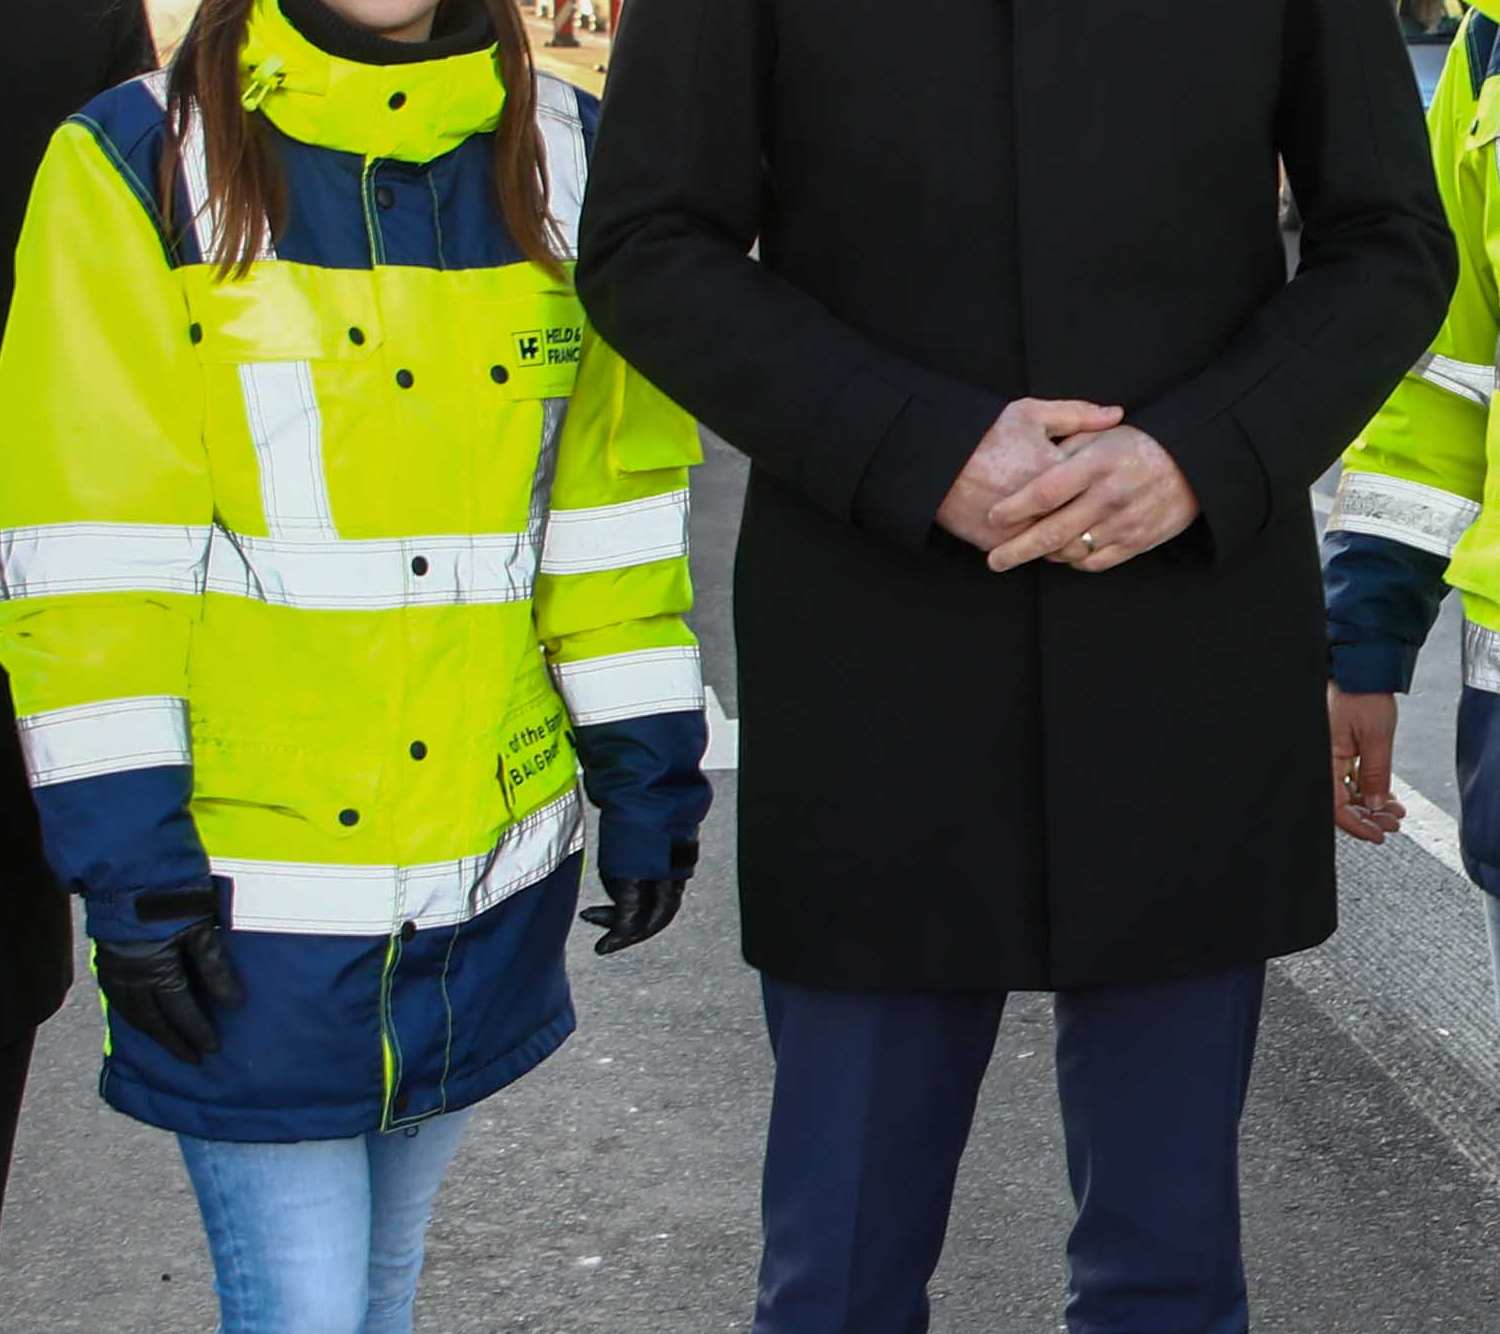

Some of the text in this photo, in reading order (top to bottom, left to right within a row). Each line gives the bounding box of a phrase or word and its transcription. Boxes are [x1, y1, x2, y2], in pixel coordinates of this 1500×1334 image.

[546, 328, 573, 344] HELD
[548, 347, 580, 365] FRANC
[521, 727, 547, 747] the
